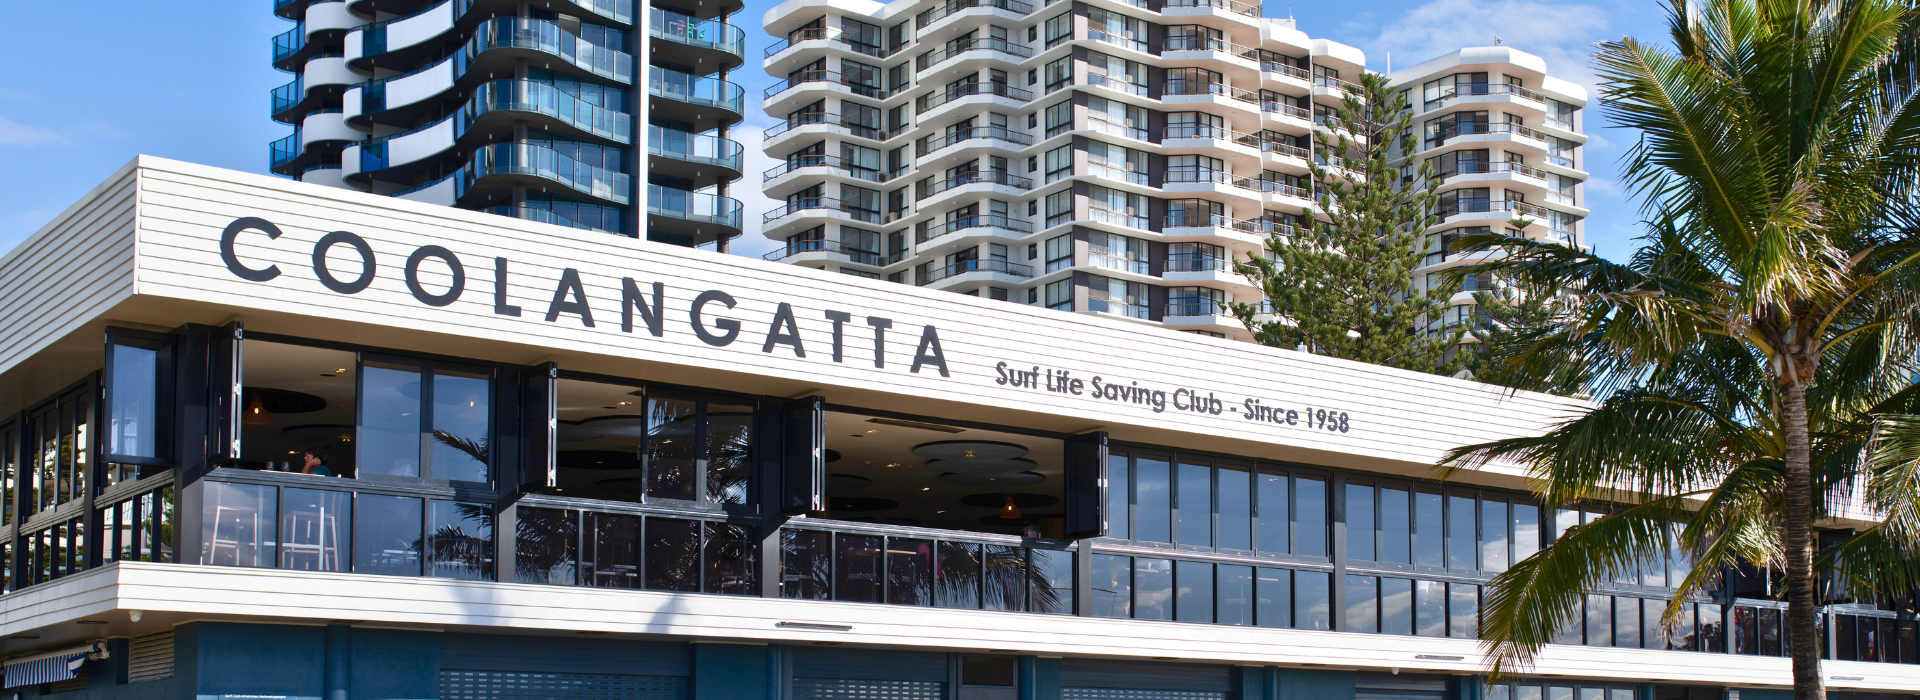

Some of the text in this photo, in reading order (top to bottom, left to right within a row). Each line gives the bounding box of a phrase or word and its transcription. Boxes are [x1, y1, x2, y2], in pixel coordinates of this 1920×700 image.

[220, 217, 951, 378] COOLANGATTA
[995, 361, 1039, 389] Surf
[1047, 369, 1084, 396] Life
[1091, 376, 1166, 413] Saving
[1173, 388, 1223, 416] Club
[1243, 398, 1299, 426] Since
[1306, 407, 1350, 434] 1958
